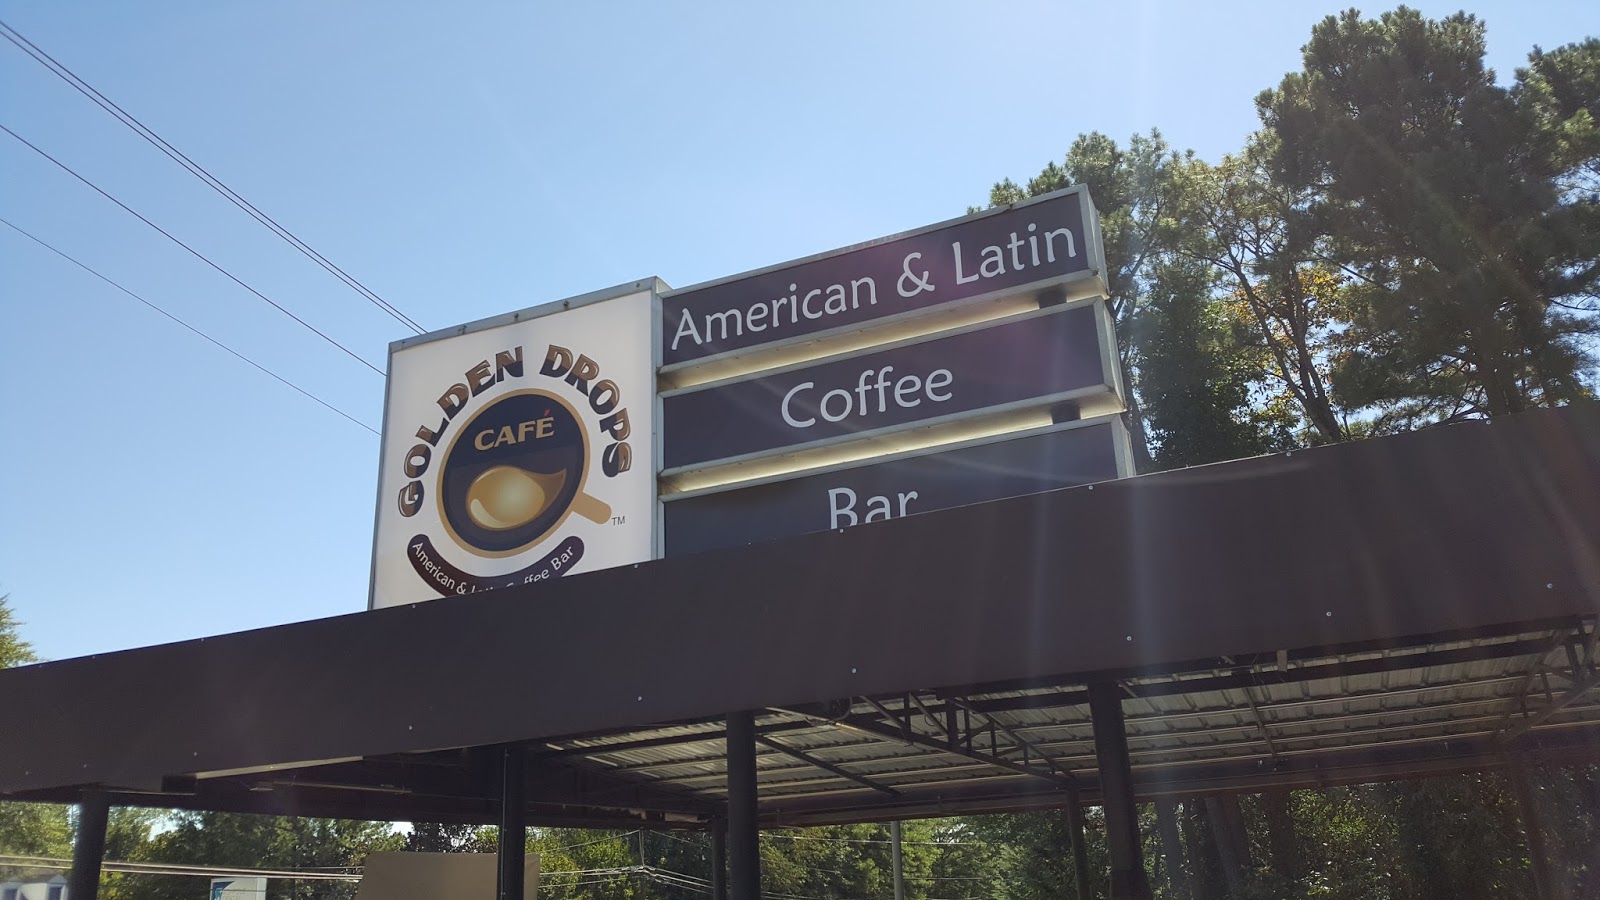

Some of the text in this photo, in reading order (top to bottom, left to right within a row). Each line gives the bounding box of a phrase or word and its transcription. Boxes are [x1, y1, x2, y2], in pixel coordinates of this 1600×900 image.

[671, 223, 1077, 351] American & Latin
[781, 365, 953, 428] Coffee
[398, 344, 633, 518] GOLDEN DROPS
[474, 409, 555, 451] CAFÉ
[611, 515, 626, 526] TM
[828, 487, 918, 529] Bar
[412, 542, 456, 590] American
[456, 581, 467, 595] &
[550, 546, 574, 571] Bar
